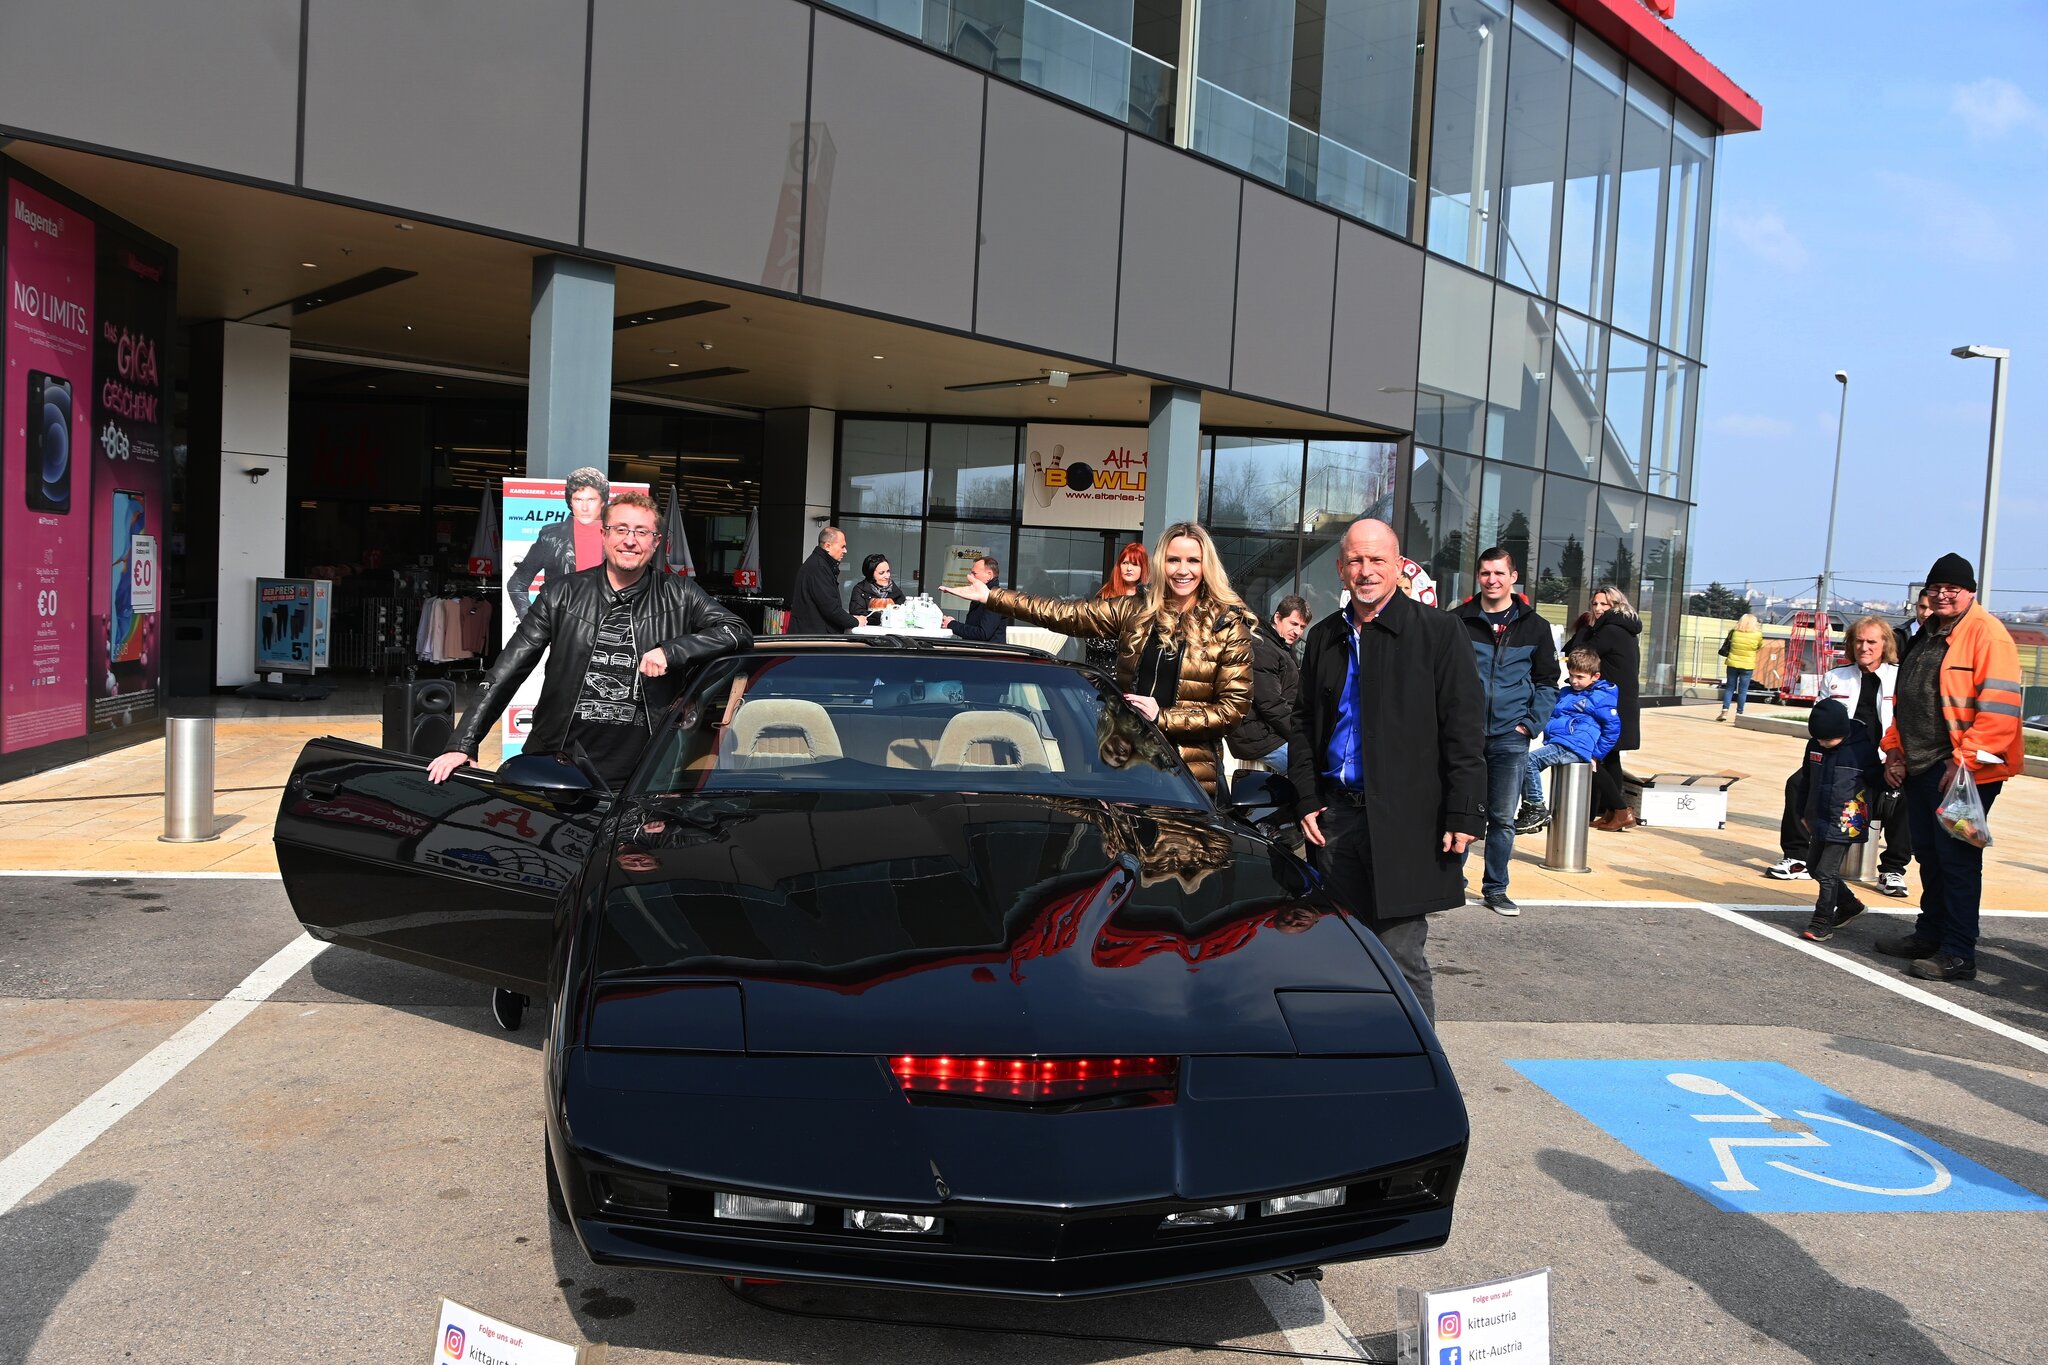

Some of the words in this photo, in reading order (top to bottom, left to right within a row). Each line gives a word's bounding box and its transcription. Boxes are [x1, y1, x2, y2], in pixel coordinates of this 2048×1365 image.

[15, 198, 58, 238] Magenta
[14, 280, 40, 317] NO
[104, 320, 118, 344] DAS
[117, 328, 159, 387] GIGA
[102, 379, 158, 424] GESCHENK
[134, 559, 152, 587] €0
[37, 590, 58, 617] €0
[1472, 1295, 1489, 1304] Folge
[1490, 1293, 1501, 1301] uns
[1501, 1290, 1513, 1298] auf:
[1468, 1310, 1517, 1330] kittaustria
[478, 1324, 496, 1338] Folge
[496, 1334, 509, 1343] uns
[509, 1337, 524, 1348] auf:
[1469, 1340, 1523, 1362] Kitt-Austria
